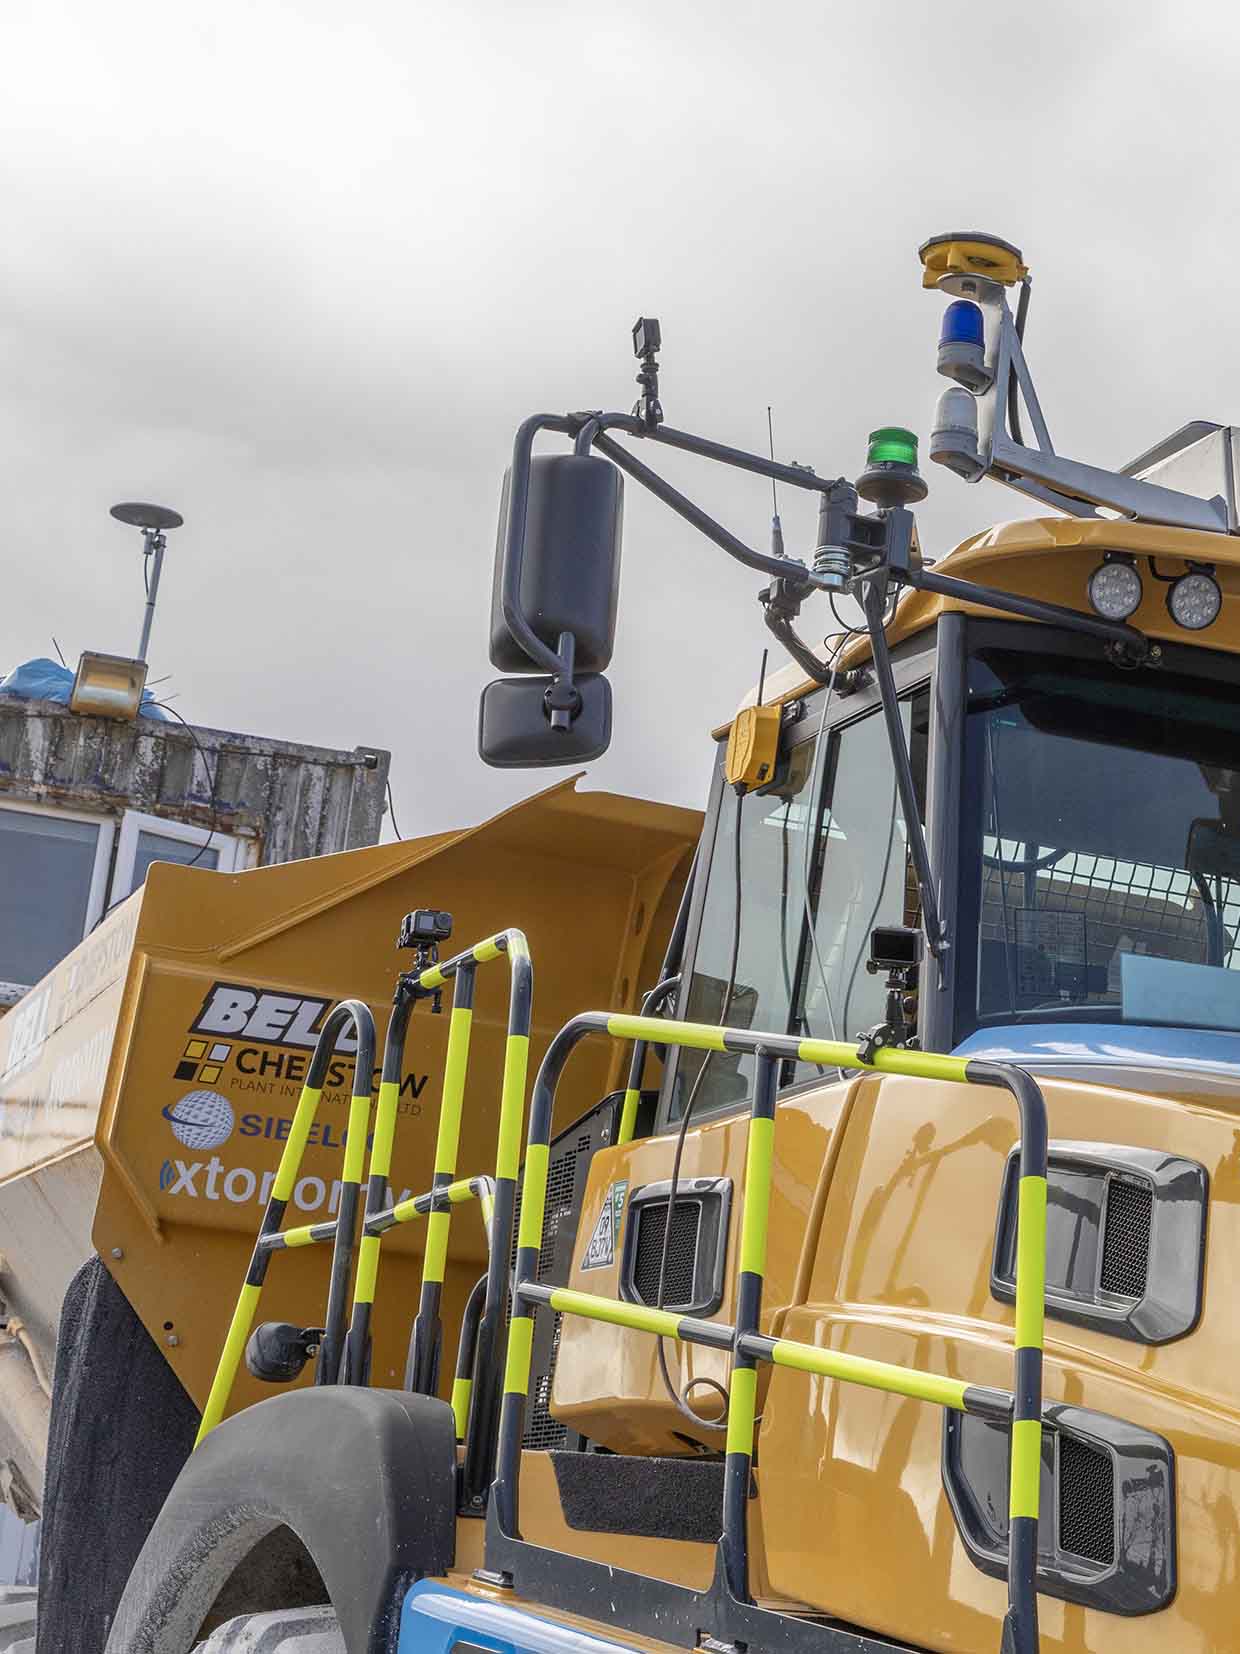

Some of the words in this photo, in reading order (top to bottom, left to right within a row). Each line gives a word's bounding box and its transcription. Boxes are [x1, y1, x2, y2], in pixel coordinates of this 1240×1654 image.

[230, 1078, 275, 1096] PLANT
[235, 1048, 429, 1099] CHESOW
[238, 1112, 376, 1154] SIBEL
